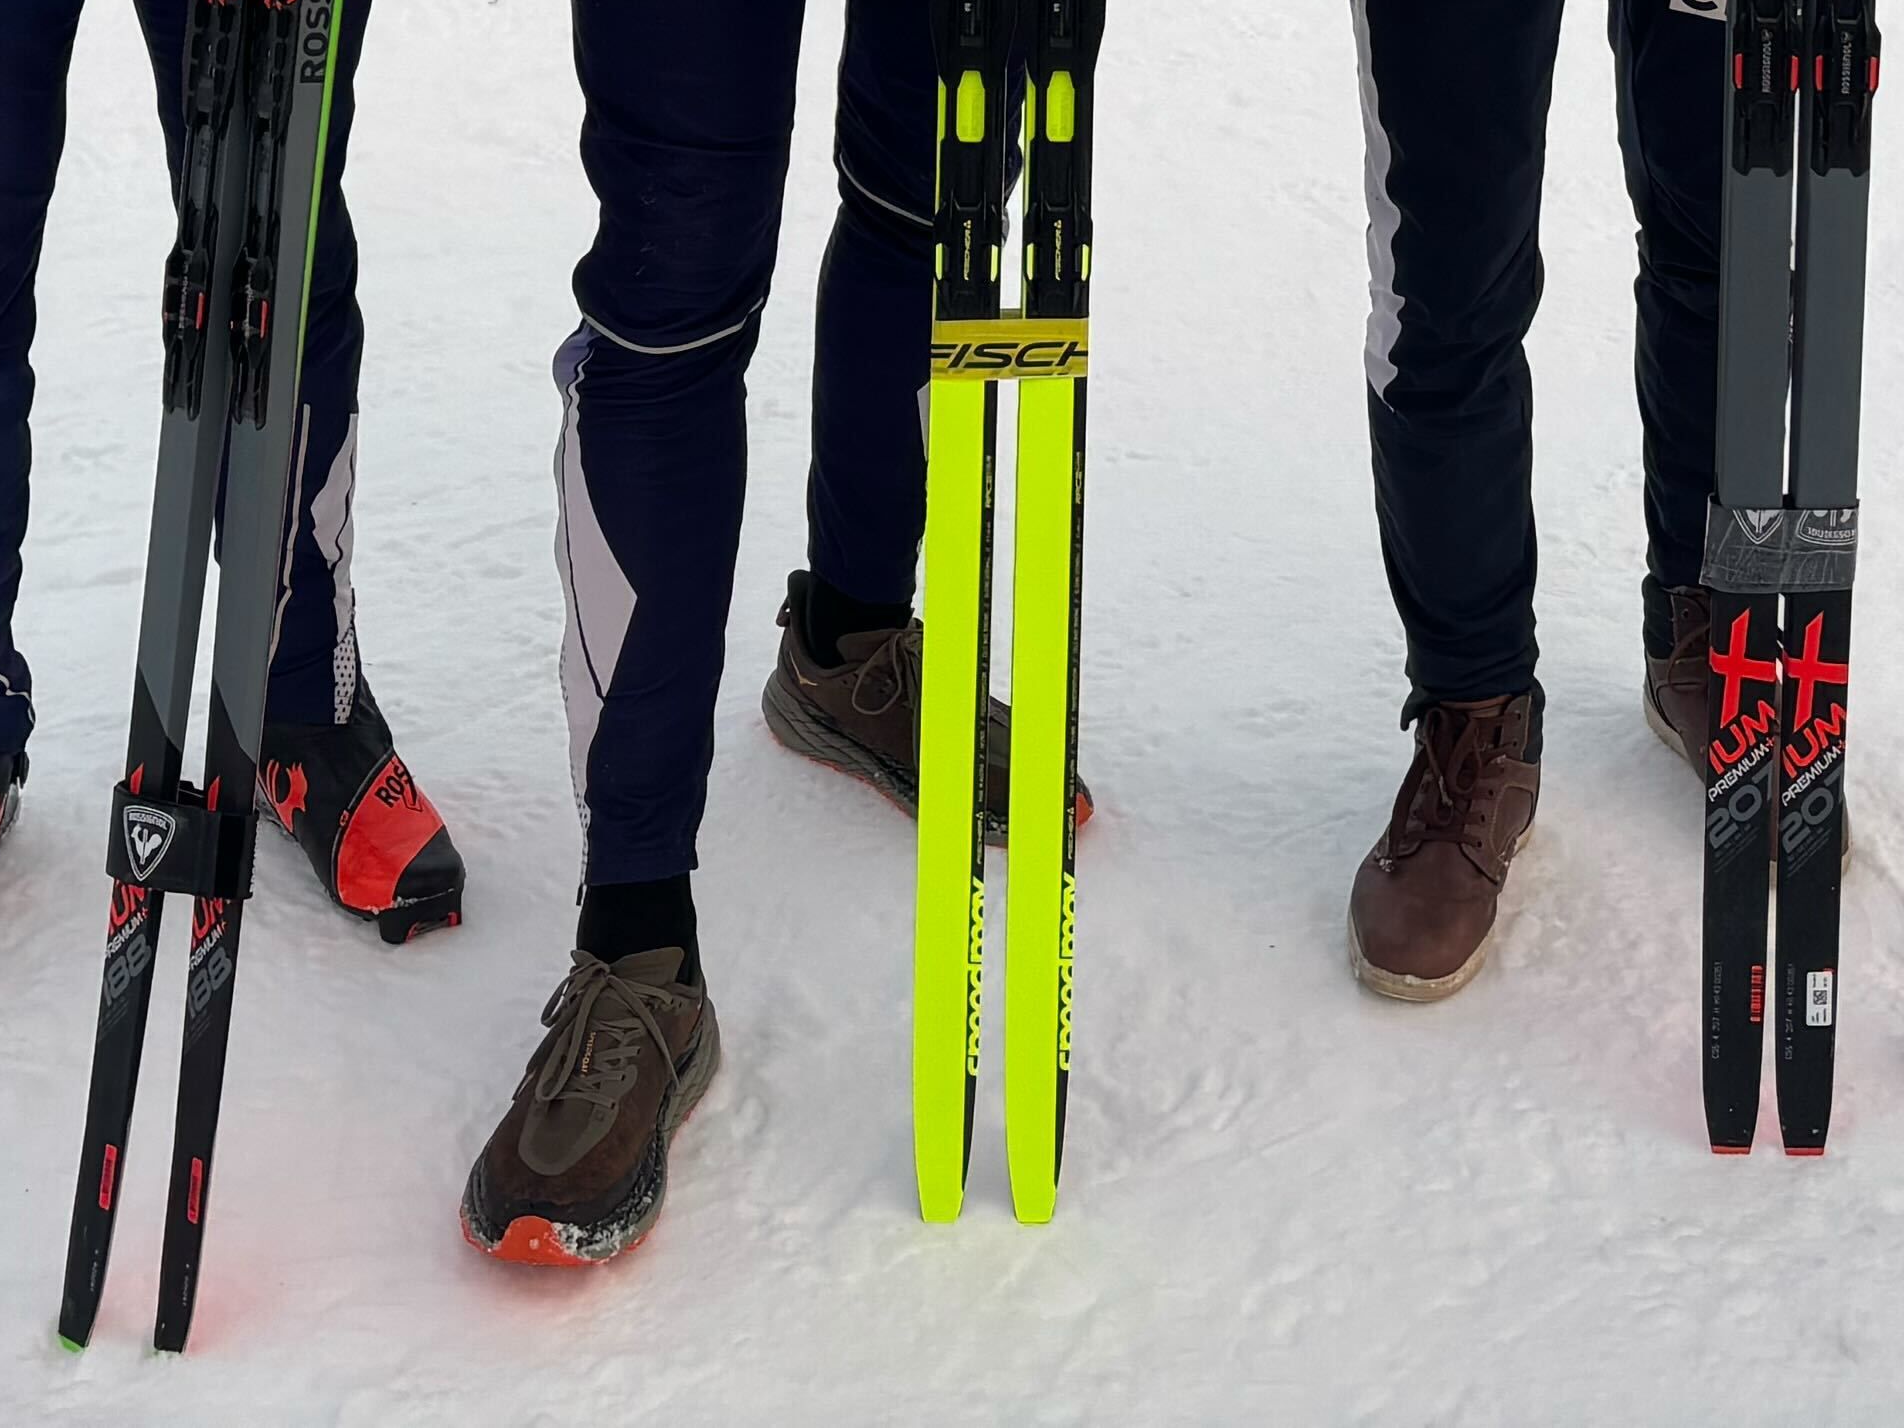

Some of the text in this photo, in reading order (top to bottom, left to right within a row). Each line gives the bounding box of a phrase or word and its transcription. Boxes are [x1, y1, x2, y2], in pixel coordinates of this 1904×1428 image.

[963, 228, 972, 281] FISCHER
[1054, 228, 1063, 281] FISCHER
[1705, 765, 1774, 850] 207
[104, 933, 153, 1008] 188
